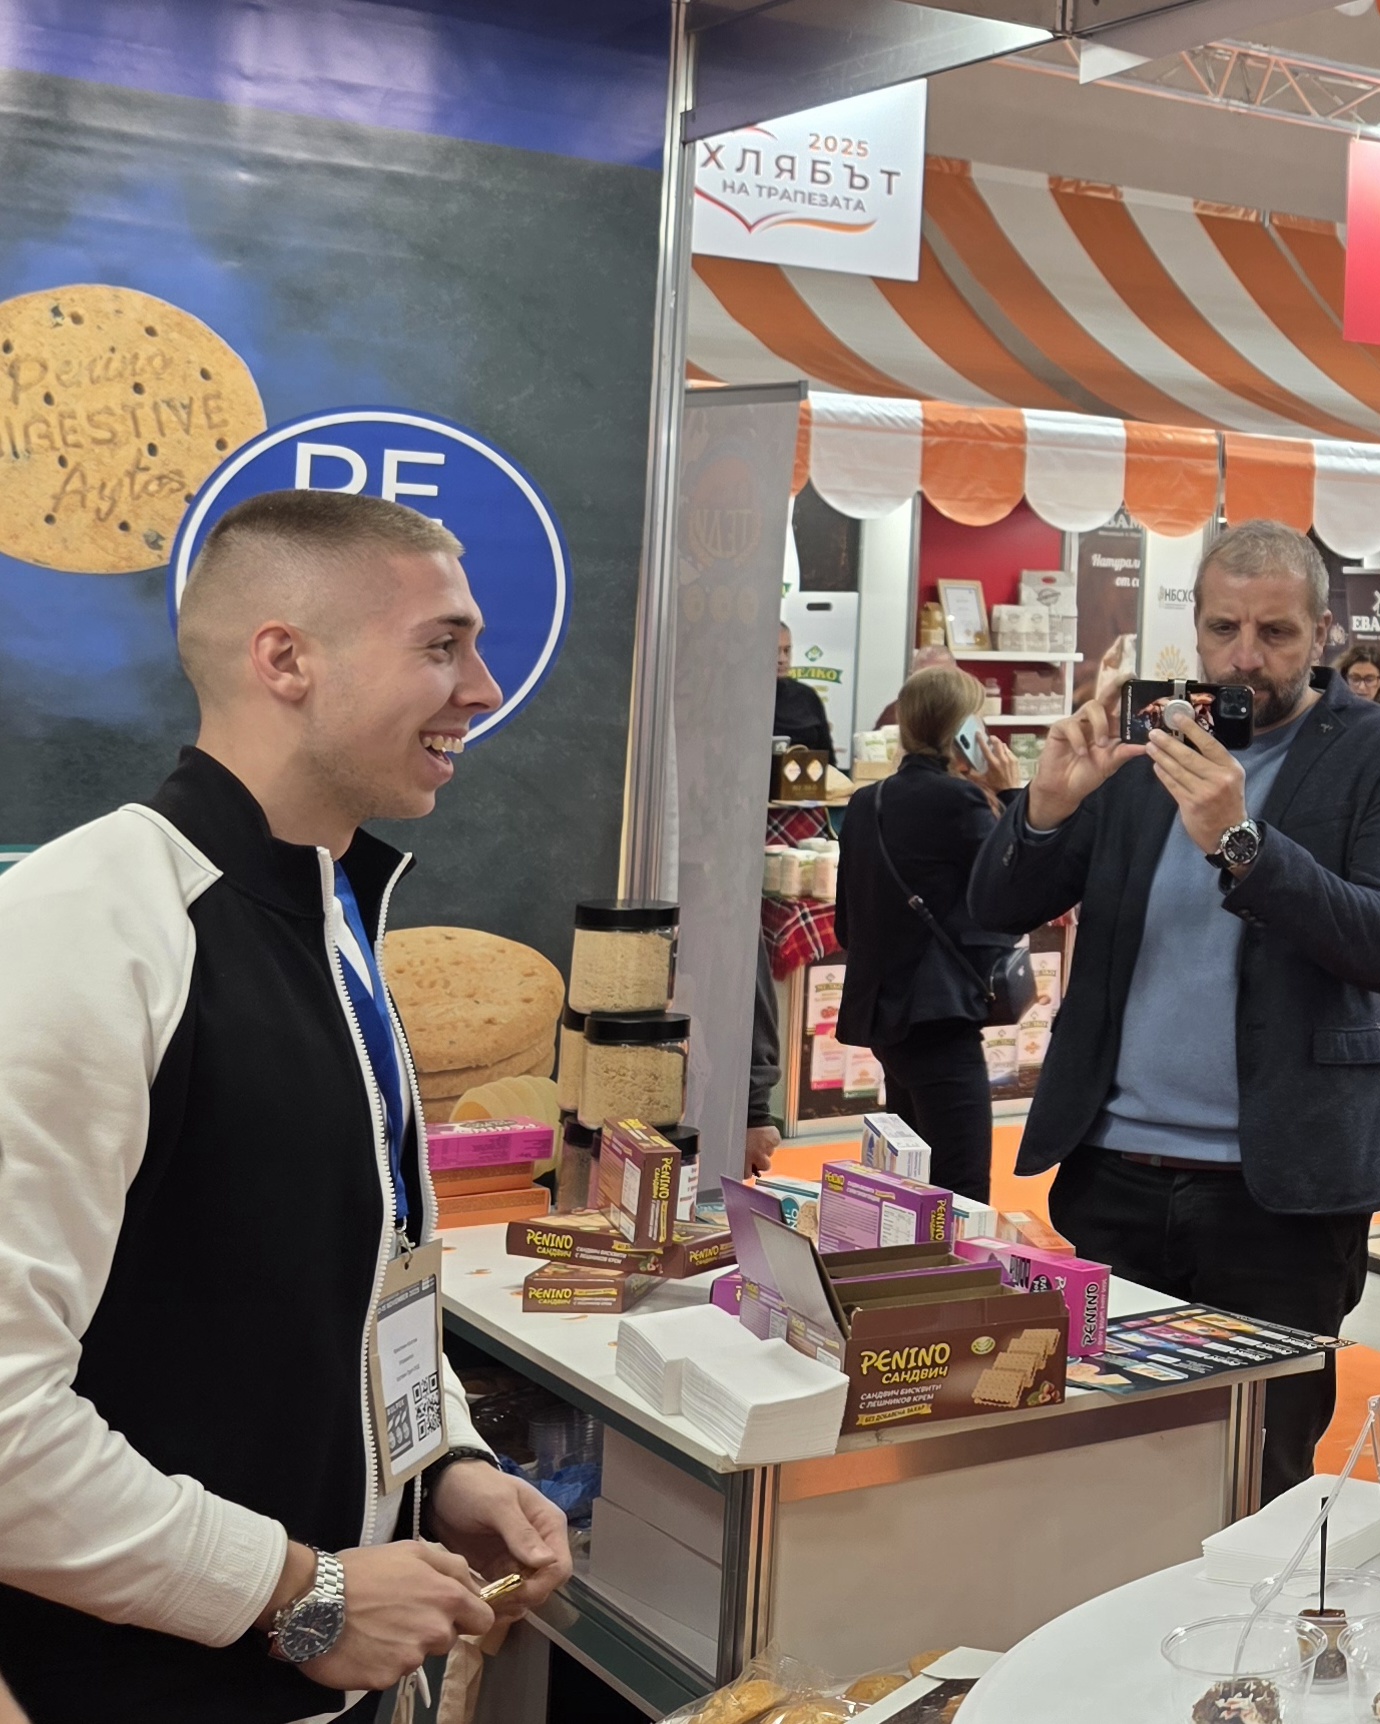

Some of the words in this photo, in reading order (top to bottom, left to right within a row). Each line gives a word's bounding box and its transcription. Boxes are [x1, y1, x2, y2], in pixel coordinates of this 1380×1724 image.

[809, 133, 869, 158] 2025
[701, 142, 901, 195] ХЛЯБЪТ
[722, 179, 750, 197] НА
[755, 184, 866, 213] ТРАПЕЗАТА
[8, 351, 173, 406] Penino
[0, 391, 229, 460] IGESTIVE
[52, 447, 187, 522] Aytos
[658, 1157, 673, 1199] PENINO
[935, 1198, 947, 1241] PENINO
[526, 1229, 574, 1250] PENINO
[528, 1286, 572, 1299] PENINO
[1081, 1281, 1099, 1348] PENINO
[860, 1342, 951, 1376] PENINO
[881, 1365, 949, 1385] САНДВИЧ
[859, 1401, 865, 1409] С
[867, 1397, 911, 1409] ЛЕШНИКОВ
[912, 1393, 935, 1403] КРЕМ
[860, 1388, 899, 1401] САНДВИЧ
[900, 1383, 942, 1396] БИСКВИТИ
